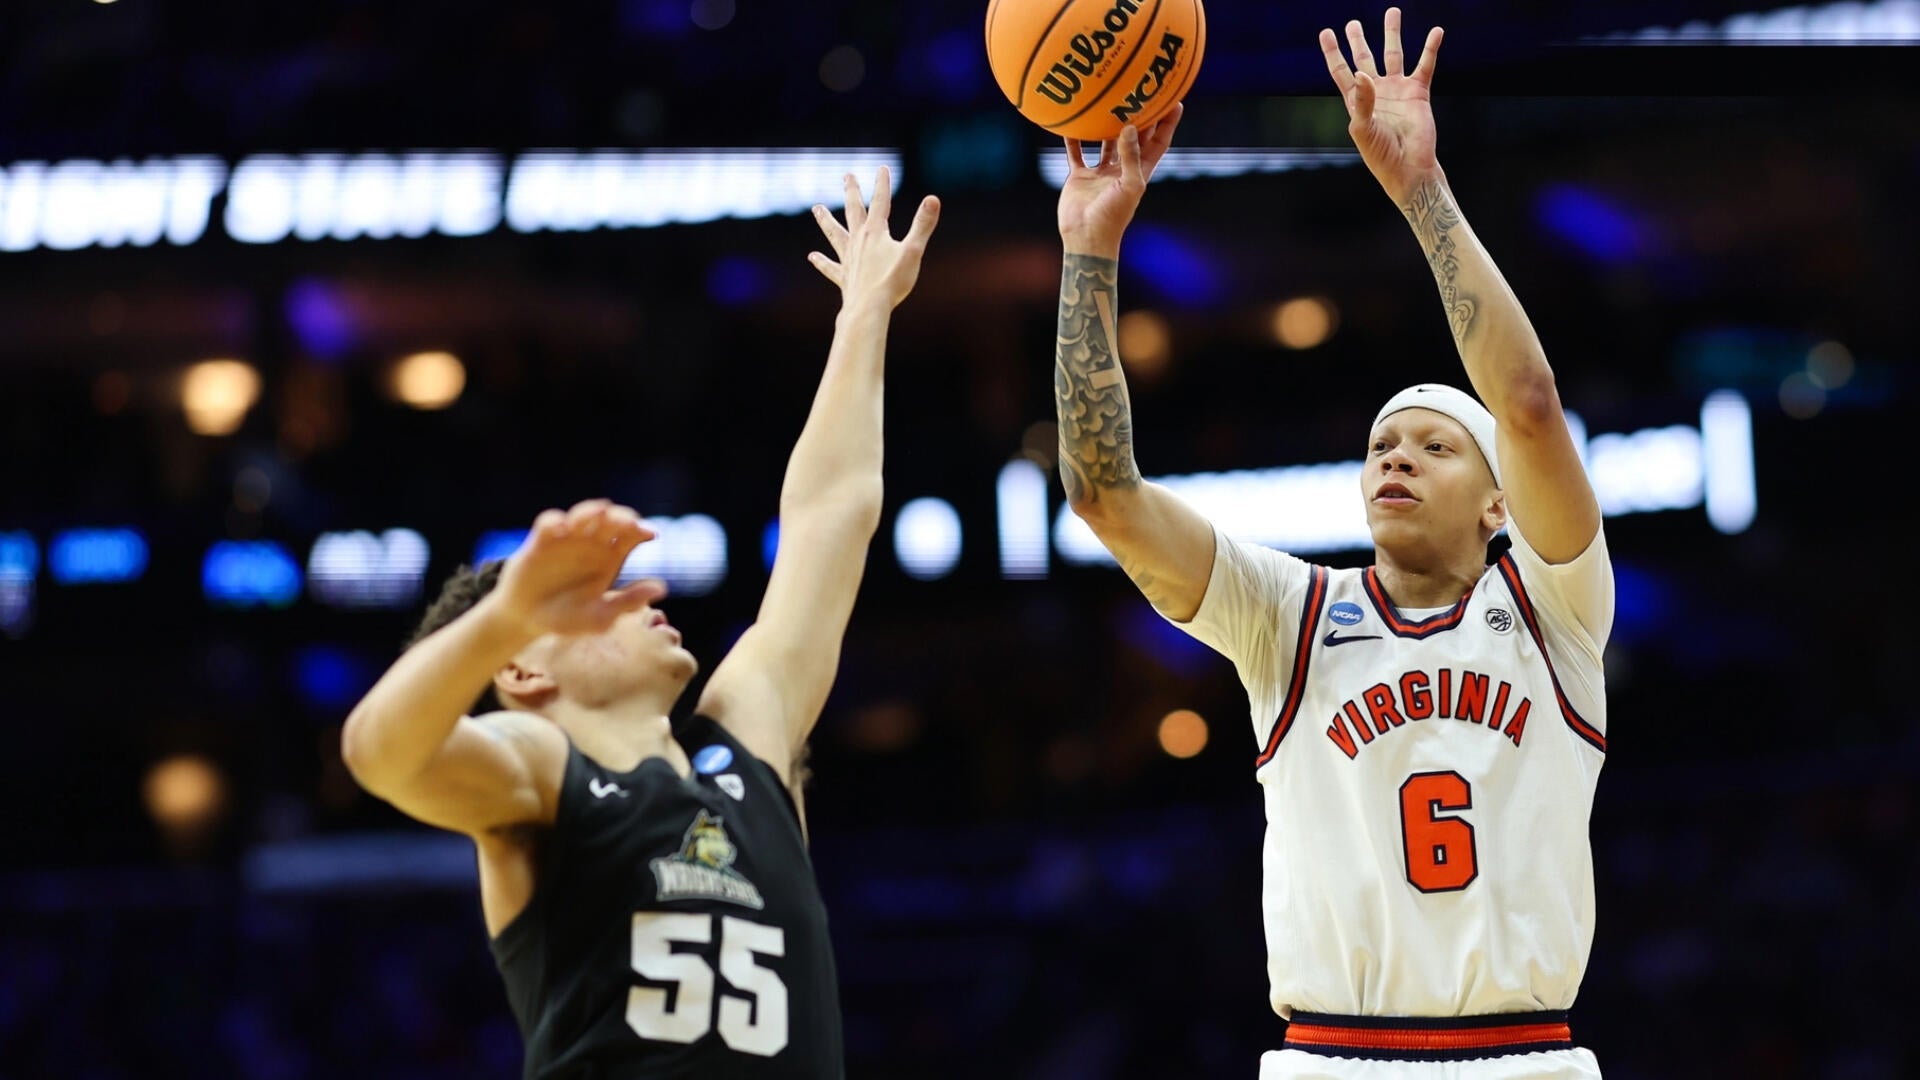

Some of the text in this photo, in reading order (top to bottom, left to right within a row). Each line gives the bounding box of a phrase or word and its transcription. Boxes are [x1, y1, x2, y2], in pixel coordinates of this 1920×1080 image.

[1110, 32, 1184, 123] NCAA
[1332, 609, 1361, 621] NCAA
[1327, 668, 1531, 760] VIRGINIA
[1399, 770, 1478, 894] 6
[625, 911, 788, 1057] 55
